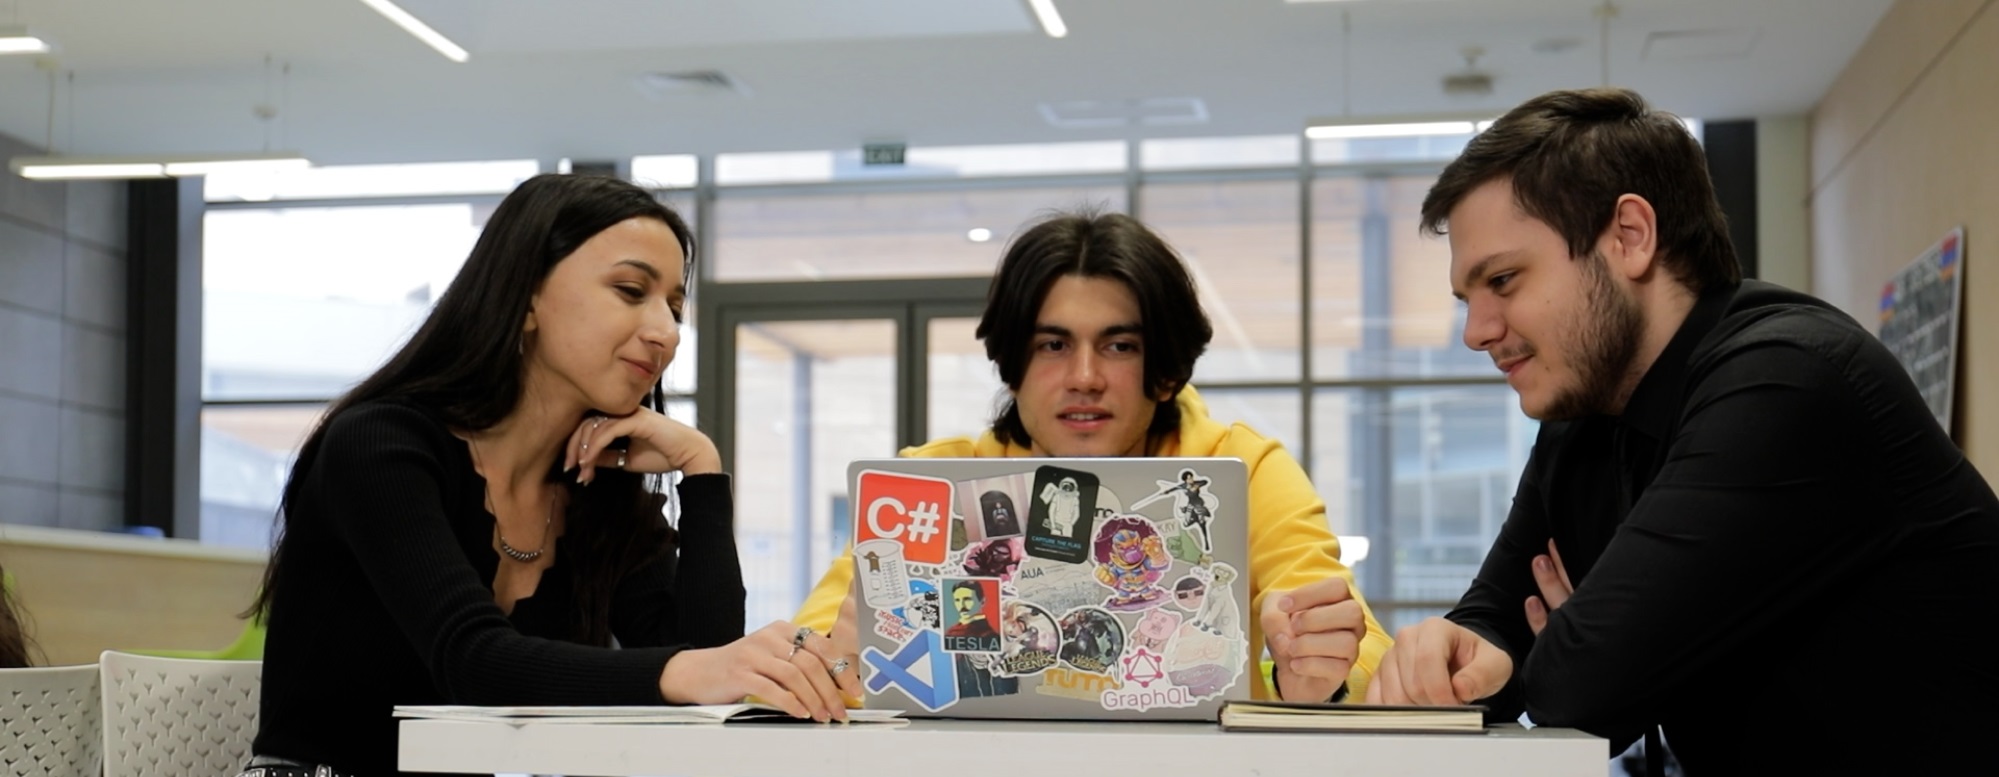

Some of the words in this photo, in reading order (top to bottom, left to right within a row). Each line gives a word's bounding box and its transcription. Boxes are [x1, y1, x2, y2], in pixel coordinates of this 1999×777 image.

[867, 497, 940, 544] C#
[1031, 536, 1056, 545] CAPTURE
[1020, 567, 1045, 580] AUA
[946, 636, 1000, 651] TESLA
[1001, 654, 1056, 674] LEGENDS
[1103, 687, 1196, 708] GraphQL
